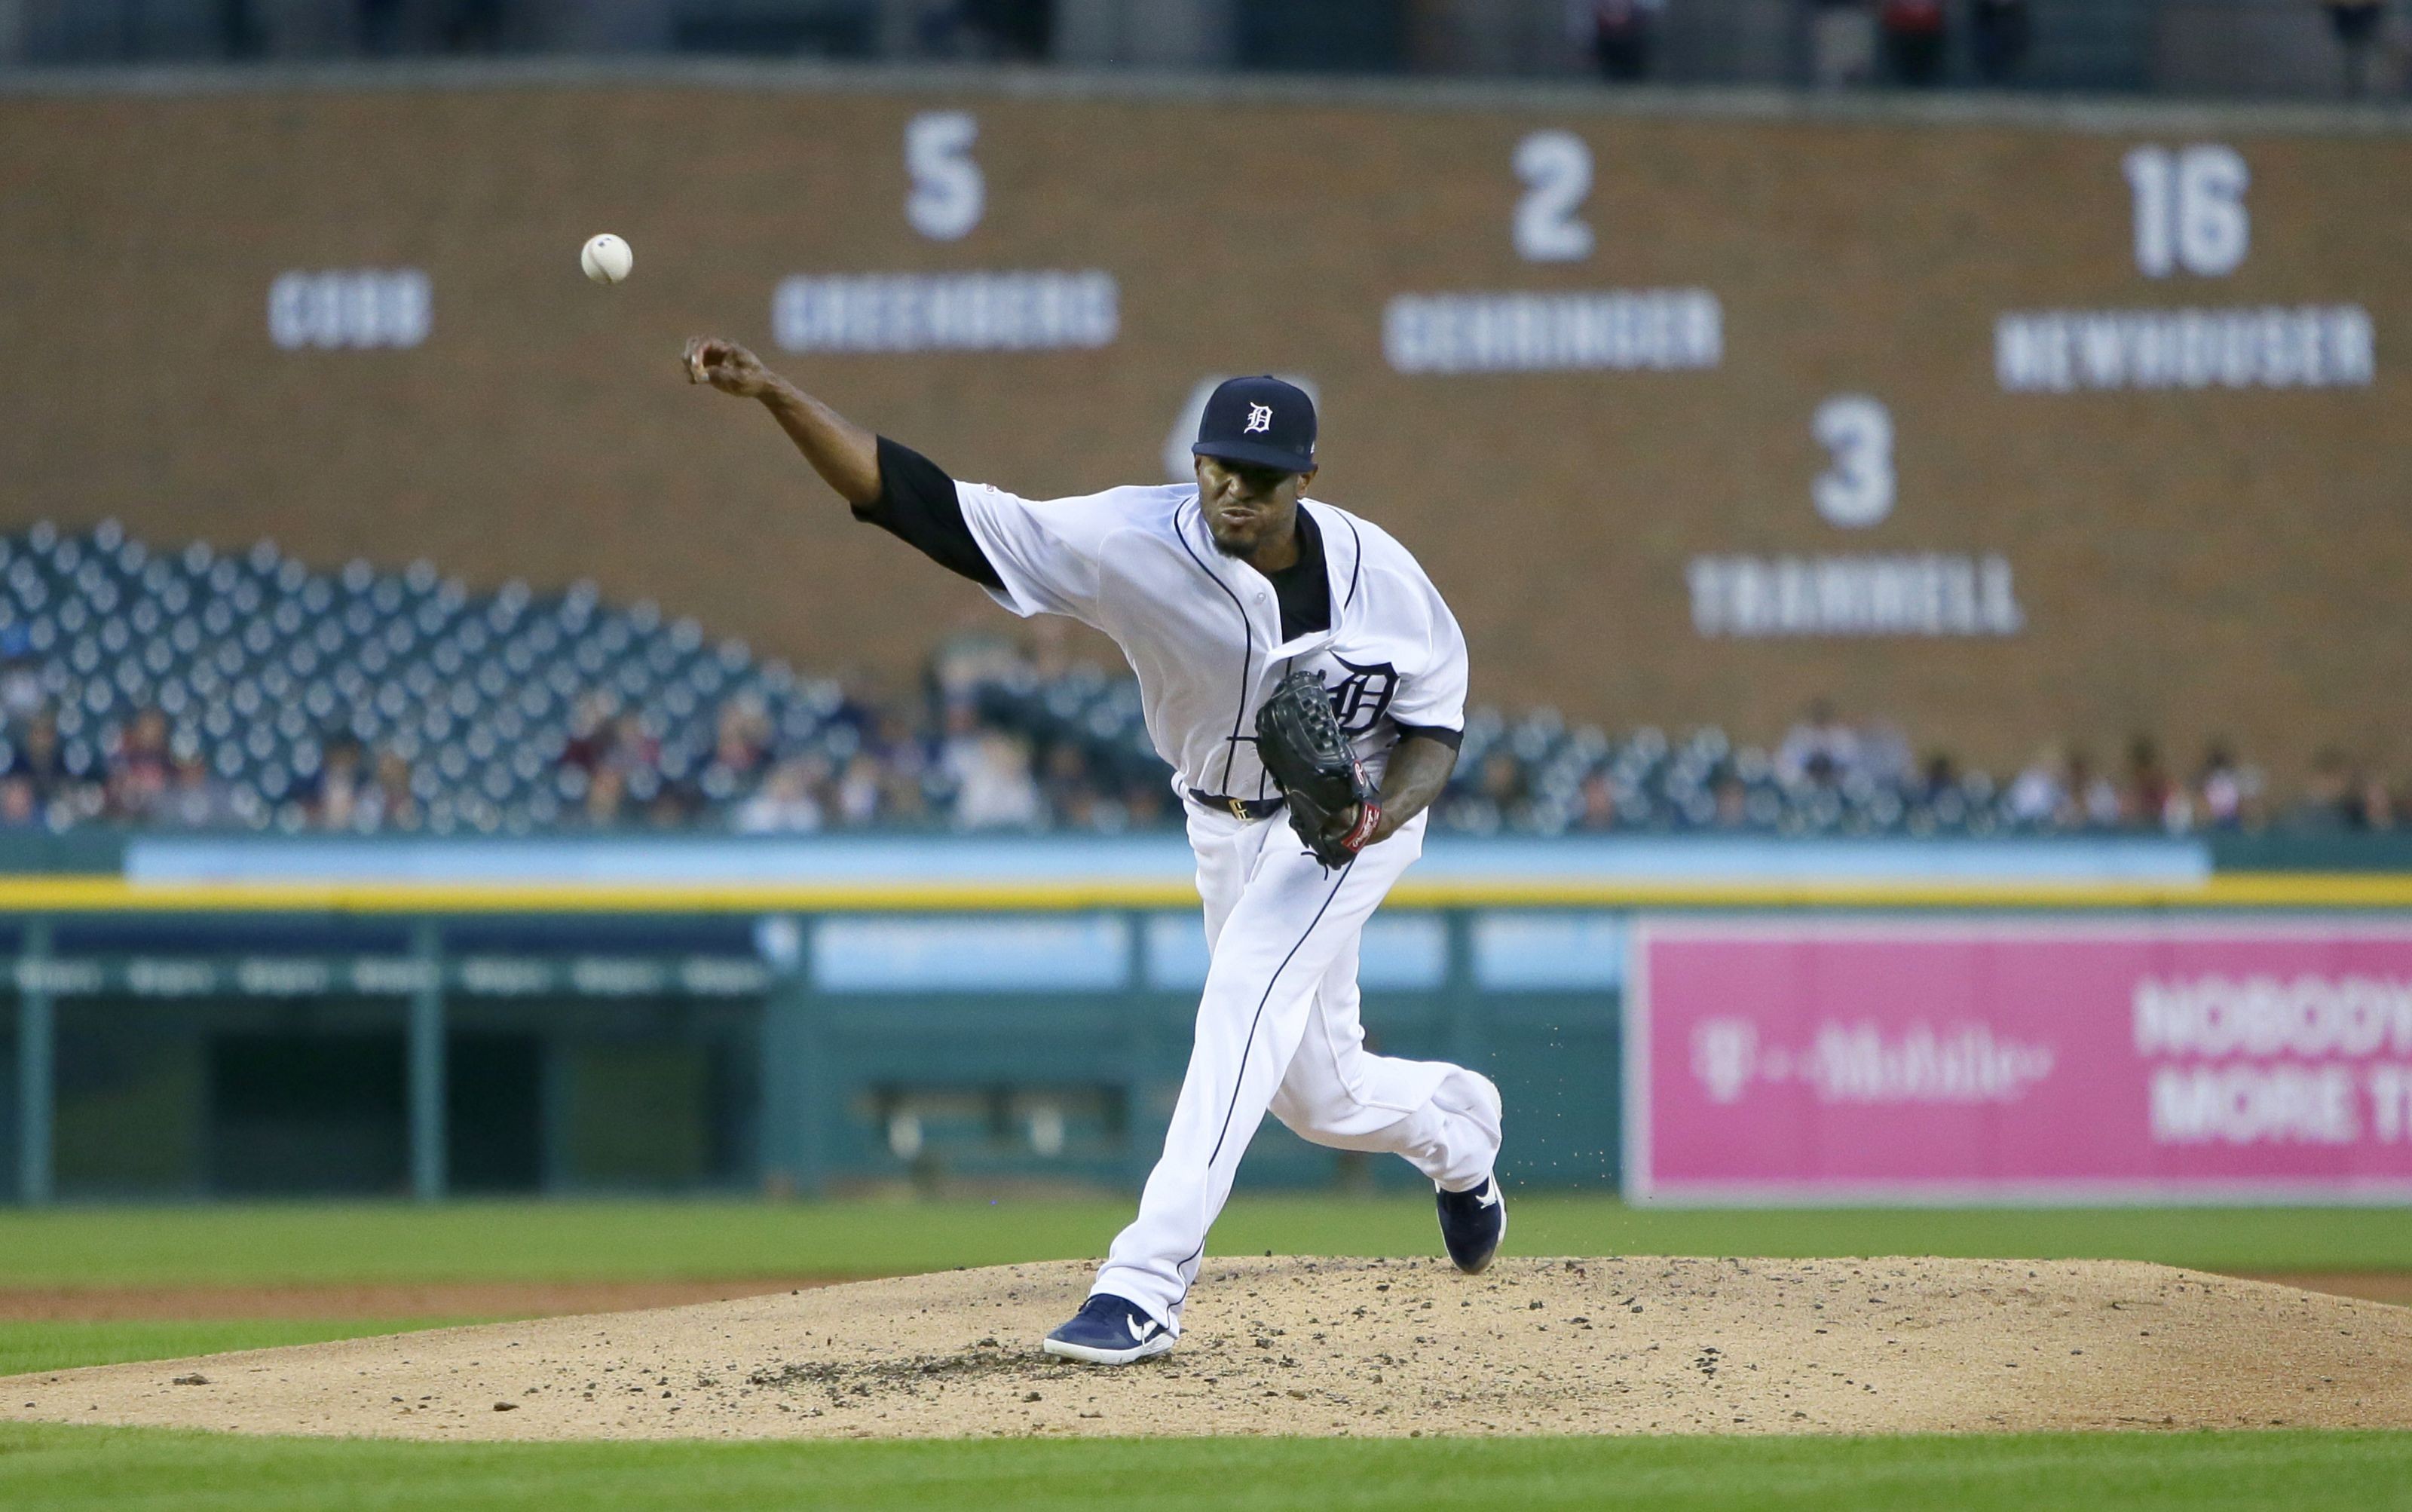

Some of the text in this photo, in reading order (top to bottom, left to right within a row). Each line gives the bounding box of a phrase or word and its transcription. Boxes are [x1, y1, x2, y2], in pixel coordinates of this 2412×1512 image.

[906, 112, 984, 240] 5
[1514, 132, 1593, 261] 2
[2125, 145, 2250, 277] 16
[1244, 402, 1273, 433] D
[1812, 396, 1896, 528] 3
[1327, 649, 1400, 737] D
[2150, 1064, 2358, 1143] MORE
